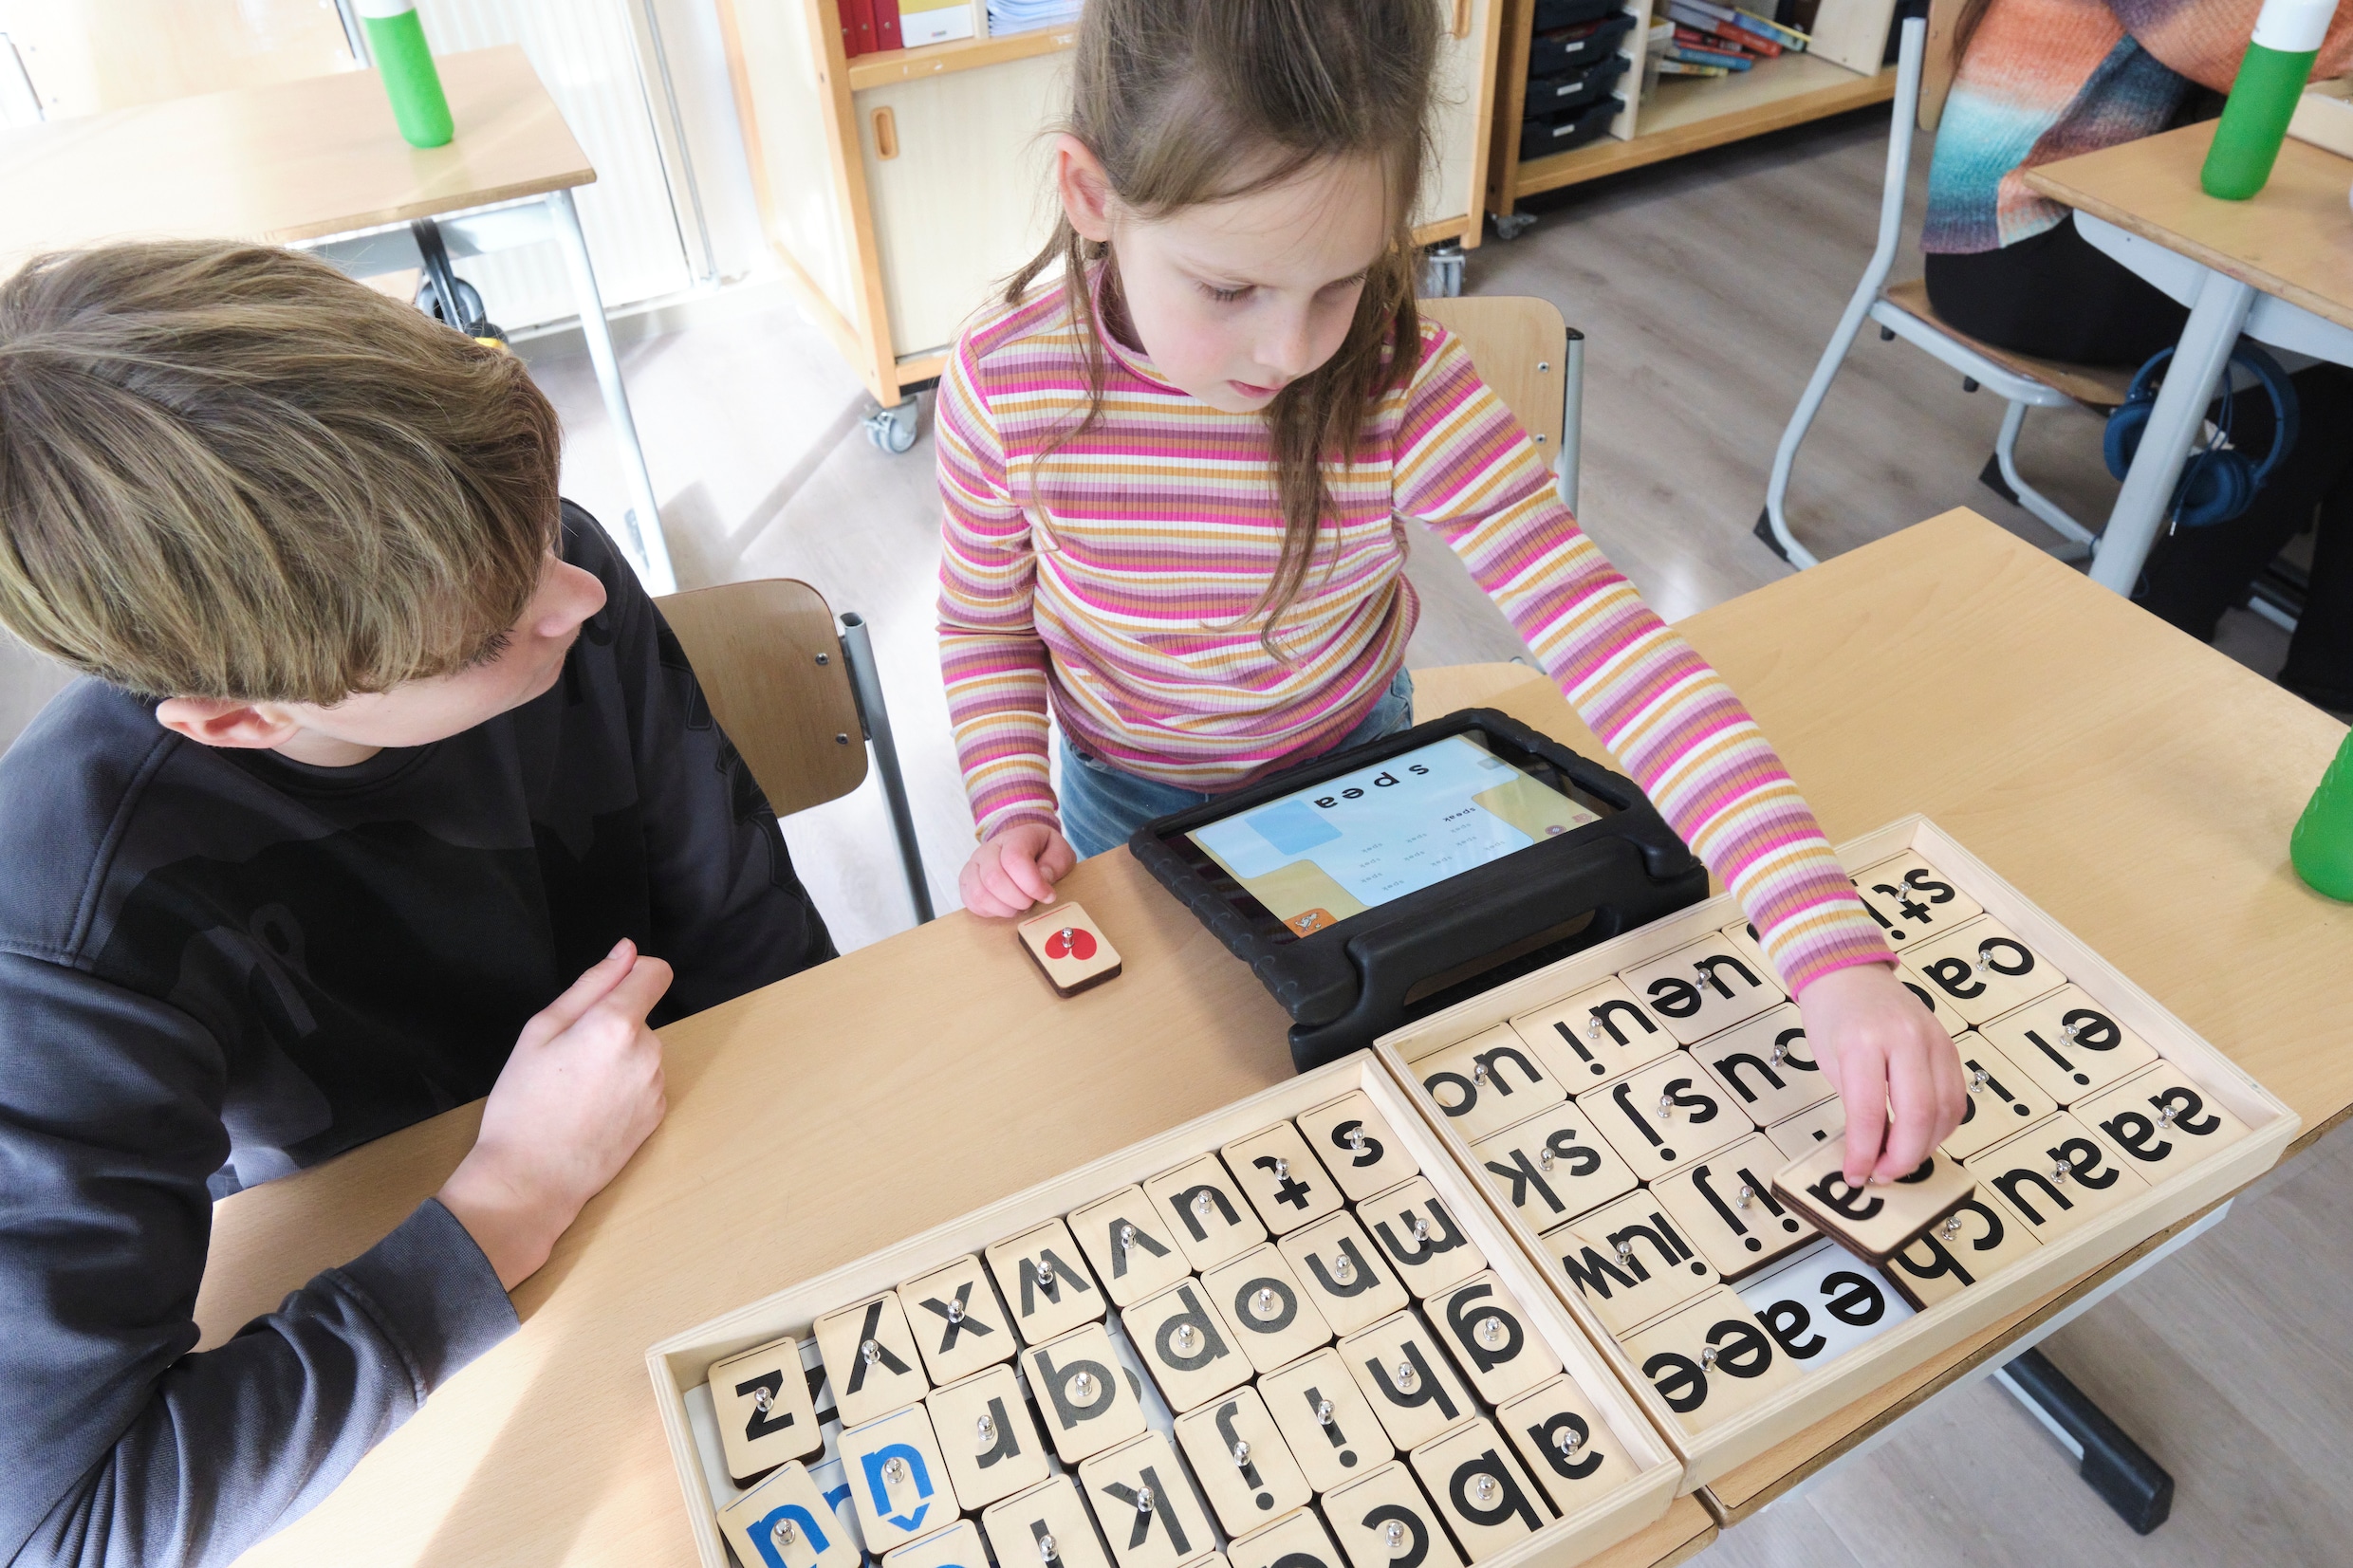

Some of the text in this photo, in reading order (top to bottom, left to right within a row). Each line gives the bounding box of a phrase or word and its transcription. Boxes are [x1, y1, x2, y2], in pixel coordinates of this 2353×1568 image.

[1442, 807, 1476, 823] speak
[1647, 954, 1763, 1019] ue
[1921, 937, 2034, 999] oa
[1553, 998, 1658, 1076] ui
[2024, 1008, 2121, 1086] ei
[1422, 1046, 1544, 1117] uo
[1612, 1078, 1718, 1161] sj
[1331, 1120, 1384, 1167] s
[2099, 1086, 2221, 1162] aa
[1252, 1156, 1311, 1210] t
[1486, 1129, 1602, 1214] sk
[1692, 1165, 1800, 1252] ij
[1991, 1137, 2121, 1226] au
[1109, 1217, 1172, 1280] v
[1170, 1185, 1242, 1242] u
[1373, 1197, 1468, 1265] m
[1896, 1198, 2005, 1287] ch
[1018, 1247, 1091, 1319] w
[1235, 1278, 1297, 1334] o
[1304, 1238, 1380, 1298] n
[846, 1301, 913, 1395] y
[918, 1281, 994, 1355] x
[1156, 1285, 1231, 1372] p
[1447, 1283, 1524, 1374] g
[1754, 1270, 1886, 1360] ea
[1034, 1350, 1116, 1430] q
[1366, 1340, 1460, 1421] h
[1642, 1319, 1773, 1413] ee
[735, 1369, 795, 1442] z
[975, 1396, 1021, 1469] r
[1304, 1387, 1358, 1468] i
[1215, 1401, 1274, 1511] j
[1527, 1411, 1604, 1480] a
[861, 1444, 935, 1533] û
[1102, 1466, 1193, 1557] k
[1450, 1448, 1545, 1533] b
[1362, 1504, 1430, 1568] c
